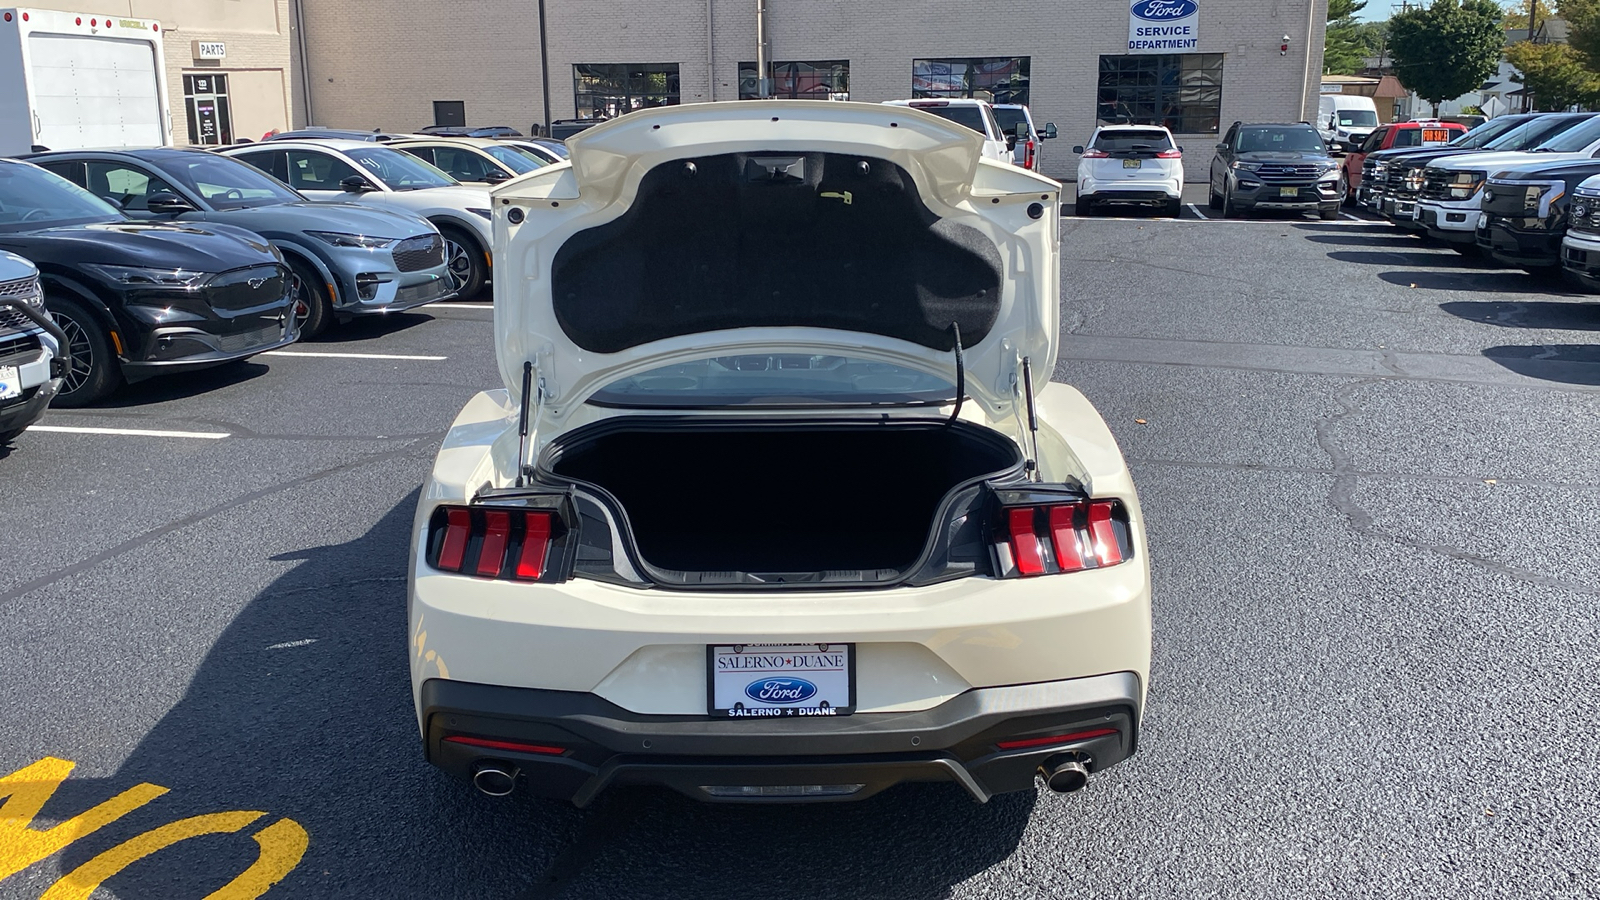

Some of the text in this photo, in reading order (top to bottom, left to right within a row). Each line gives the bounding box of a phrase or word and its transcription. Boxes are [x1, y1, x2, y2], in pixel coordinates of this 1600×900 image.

[1144, 0, 1185, 17] Ford
[1136, 26, 1191, 37] SERVICE
[200, 44, 225, 56] PARTS
[1128, 39, 1198, 50] DEPARTMENT
[1424, 131, 1447, 141] FOR SALE
[718, 655, 844, 669] SALERNO DUANE
[759, 680, 803, 699] Ford
[728, 708, 837, 717] SALERNO DUANE
